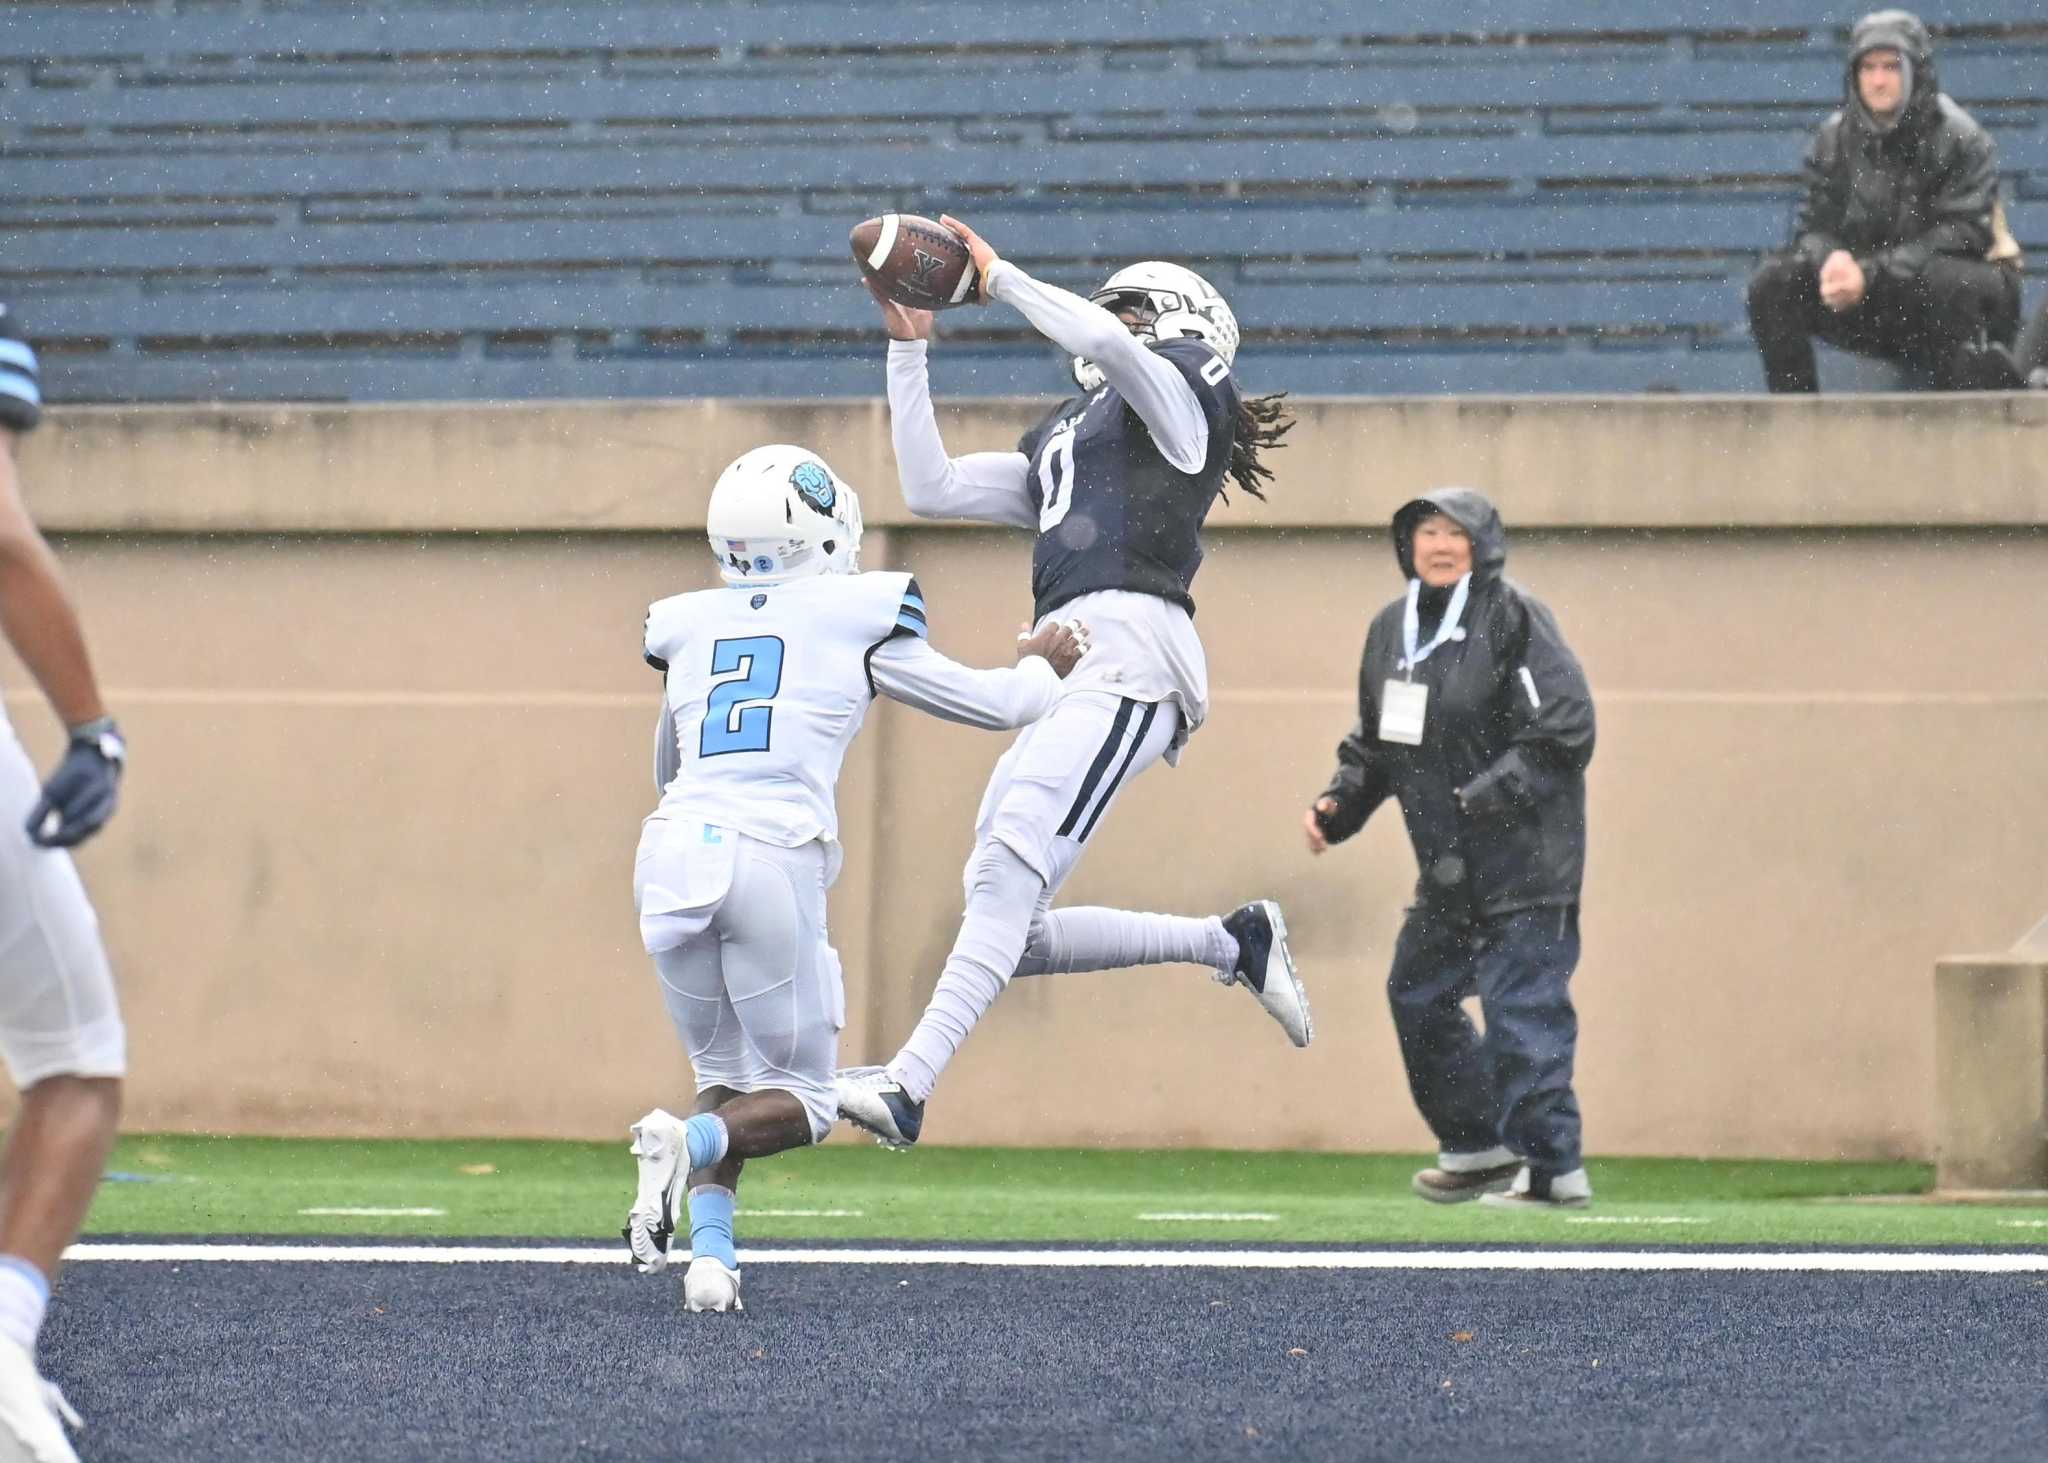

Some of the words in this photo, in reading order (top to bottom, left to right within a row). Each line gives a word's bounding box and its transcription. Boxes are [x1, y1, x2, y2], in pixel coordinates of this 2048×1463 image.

[912, 249, 944, 284] Y
[1200, 354, 1230, 387] 0
[1038, 427, 1075, 533] 0
[758, 559, 769, 570] 2
[699, 635, 785, 759] 2
